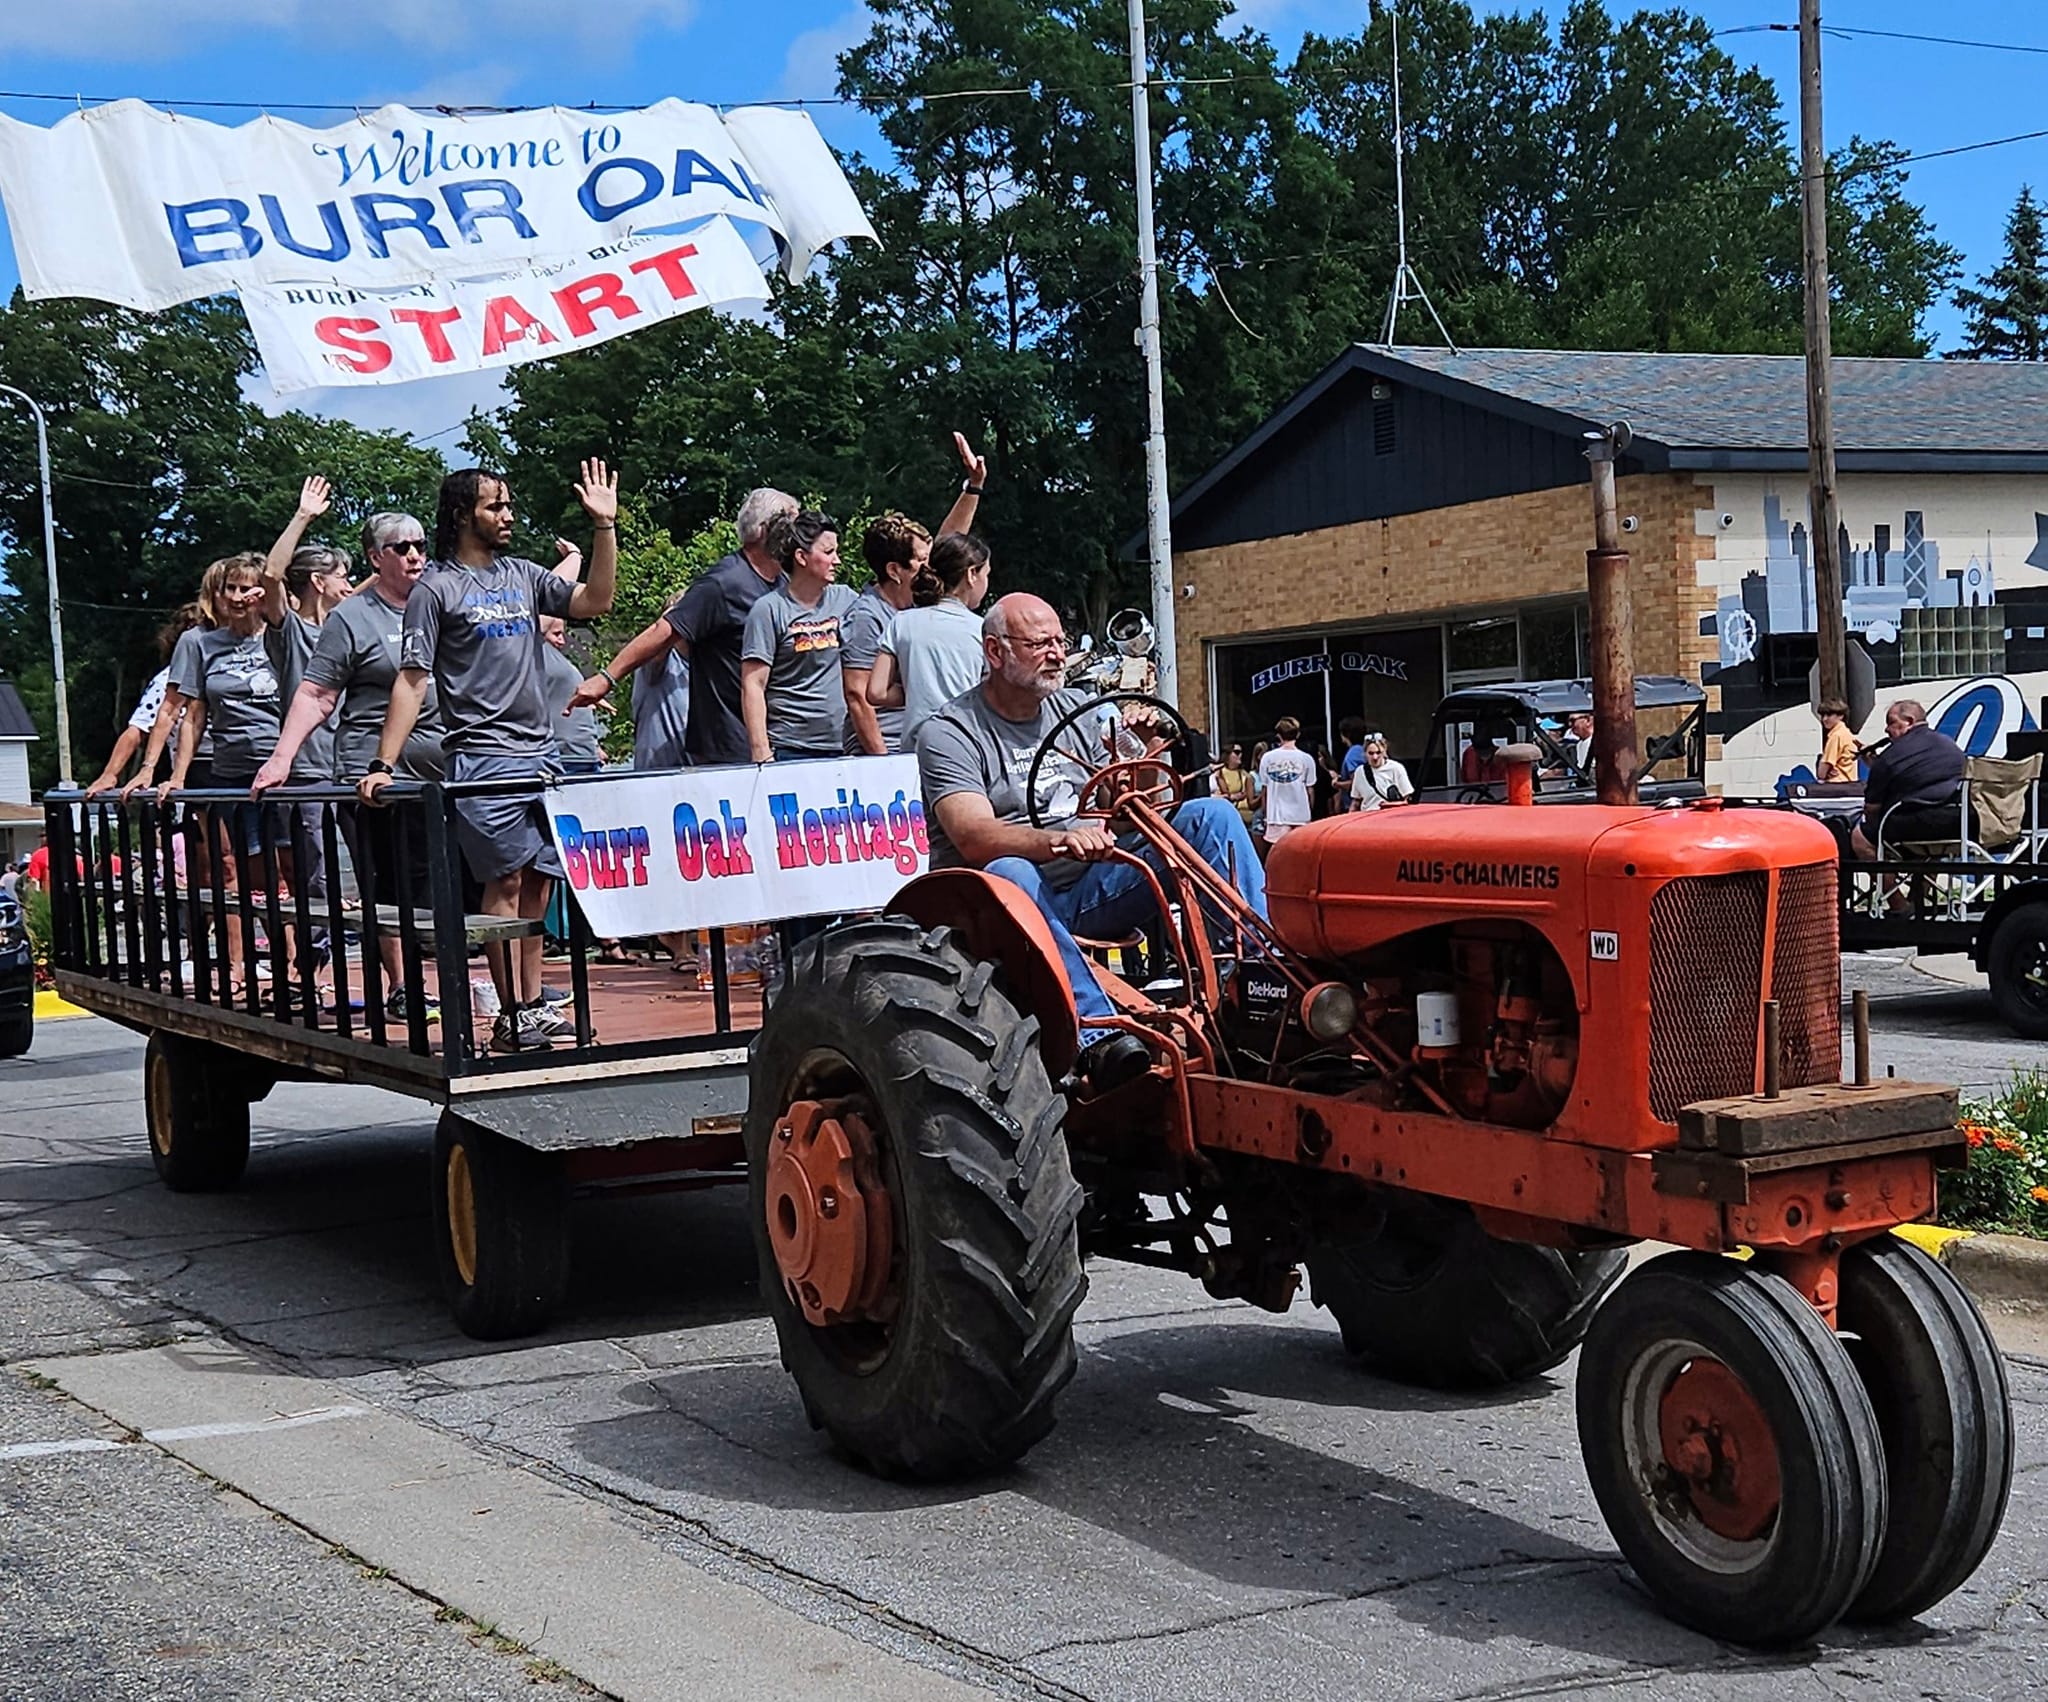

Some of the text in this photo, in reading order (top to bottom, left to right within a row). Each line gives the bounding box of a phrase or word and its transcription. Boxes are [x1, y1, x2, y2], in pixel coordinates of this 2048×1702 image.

[313, 124, 622, 187] Welcome to
[162, 178, 539, 268] BURR
[314, 242, 700, 374] START
[1251, 652, 1409, 694] BURR OAK
[555, 788, 931, 890] Burr Oak Heritage
[1396, 859, 1561, 889] ALLIS-CHALMERS
[1593, 935, 1616, 955] WD
[1247, 980, 1288, 998] DieHard
